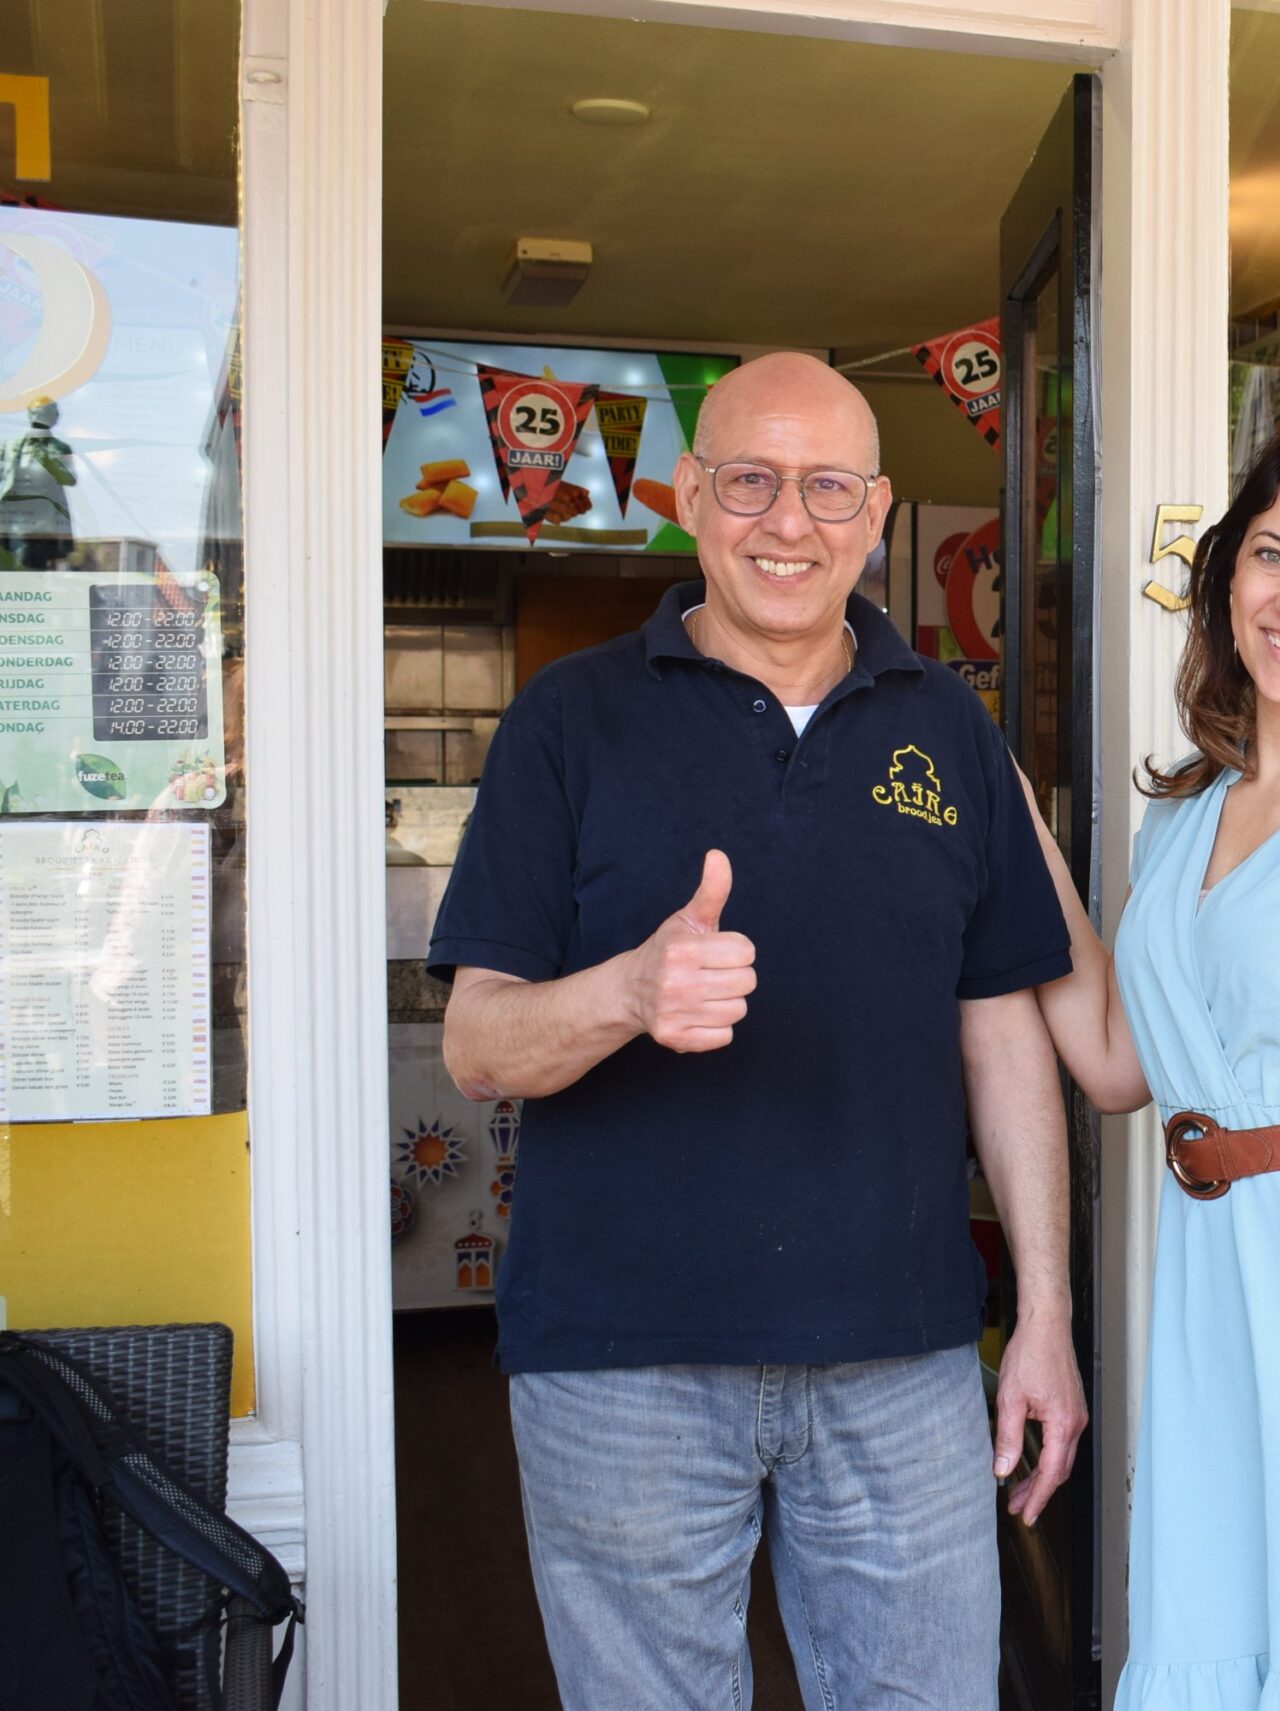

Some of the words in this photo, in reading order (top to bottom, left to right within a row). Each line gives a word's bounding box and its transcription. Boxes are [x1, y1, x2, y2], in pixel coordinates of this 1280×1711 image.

[954, 350, 998, 385] 25
[969, 392, 1000, 413] JAA
[514, 406, 561, 436] 25
[599, 405, 640, 423] PARTY
[510, 450, 560, 467] JAAR!
[1142, 505, 1203, 611] 5
[0, 591, 52, 602] ANDAG
[107, 612, 141, 627] 12.00
[154, 613, 195, 627] 22.00
[106, 634, 142, 649] 12.00
[155, 634, 196, 648] 22.00
[108, 656, 143, 670] 12.00
[155, 655, 196, 669] 22.00
[109, 677, 143, 691] 12.00
[156, 676, 197, 691] 22.00
[110, 699, 144, 713] 12.00
[156, 698, 198, 712] 22.00
[110, 721, 144, 734] 14.00
[157, 720, 198, 734] 22.00
